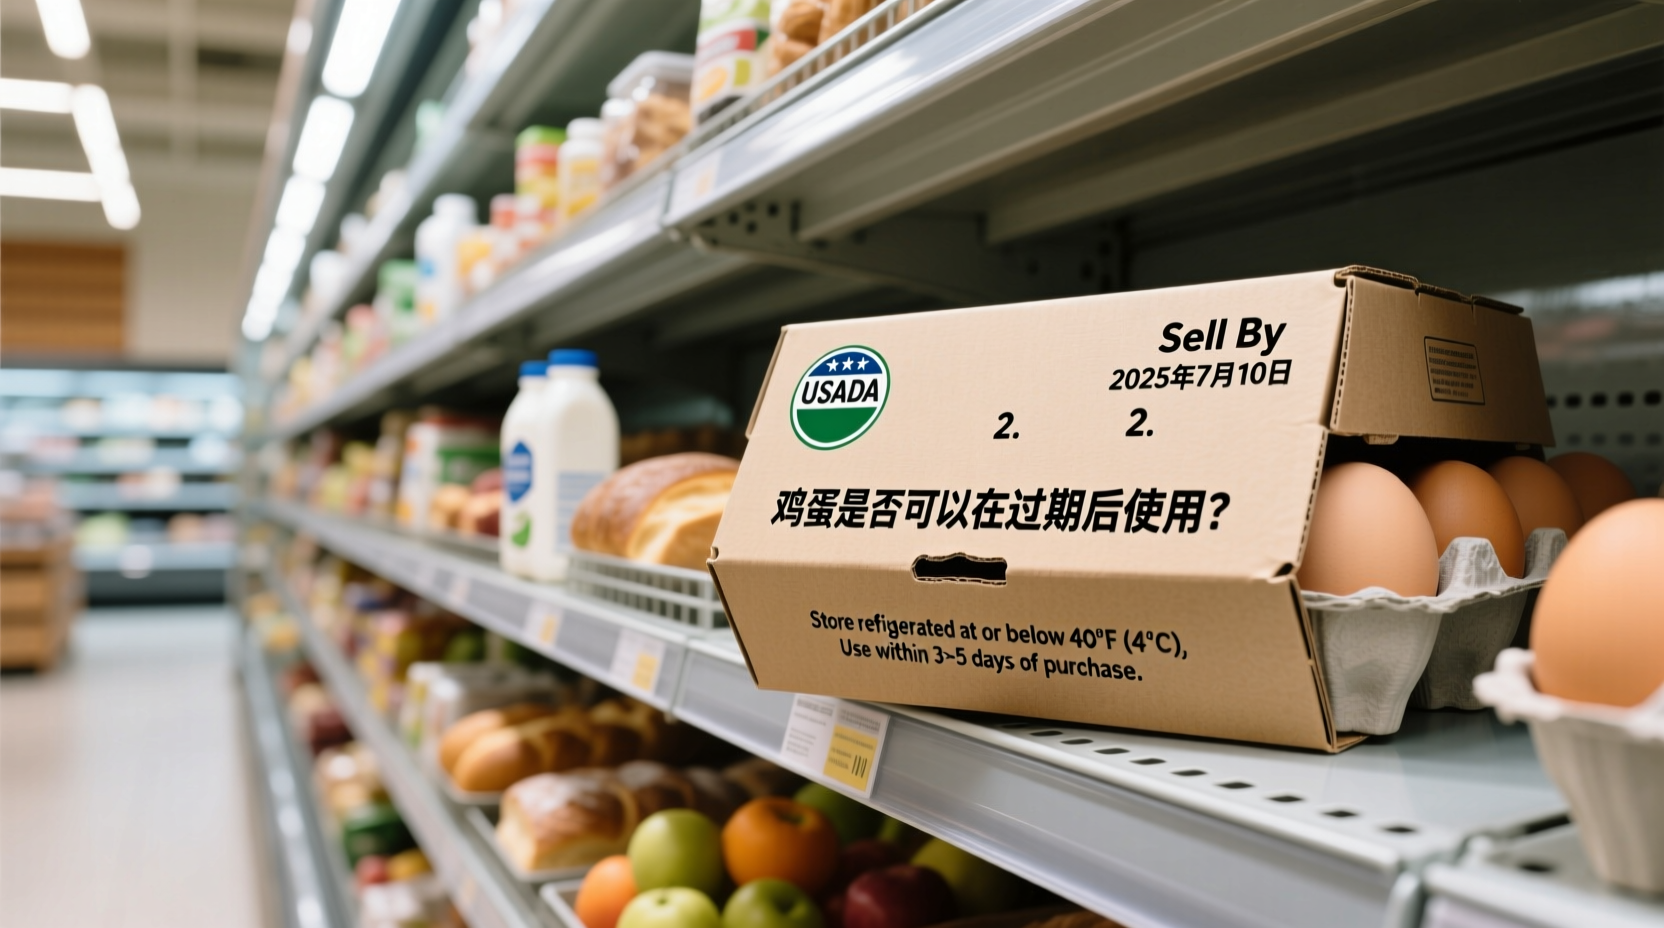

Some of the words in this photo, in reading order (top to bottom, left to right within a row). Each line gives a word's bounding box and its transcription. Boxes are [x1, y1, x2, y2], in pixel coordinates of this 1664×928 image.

[1158, 319, 1228, 354] Sell
[1235, 316, 1287, 357] By
[1108, 359, 1293, 391] 2025年7月10日
[800, 377, 880, 406] USADA
[992, 411, 1020, 440] 2.
[1125, 407, 1154, 437] 2.
[809, 609, 855, 631] Store
[959, 621, 978, 641] at
[981, 626, 1002, 642] or
[1005, 622, 1065, 647] below
[839, 638, 872, 658] Use
[874, 641, 929, 665] within
[971, 648, 1016, 674] days
[1019, 652, 1039, 673] of
[1043, 656, 1143, 682] purchase.
